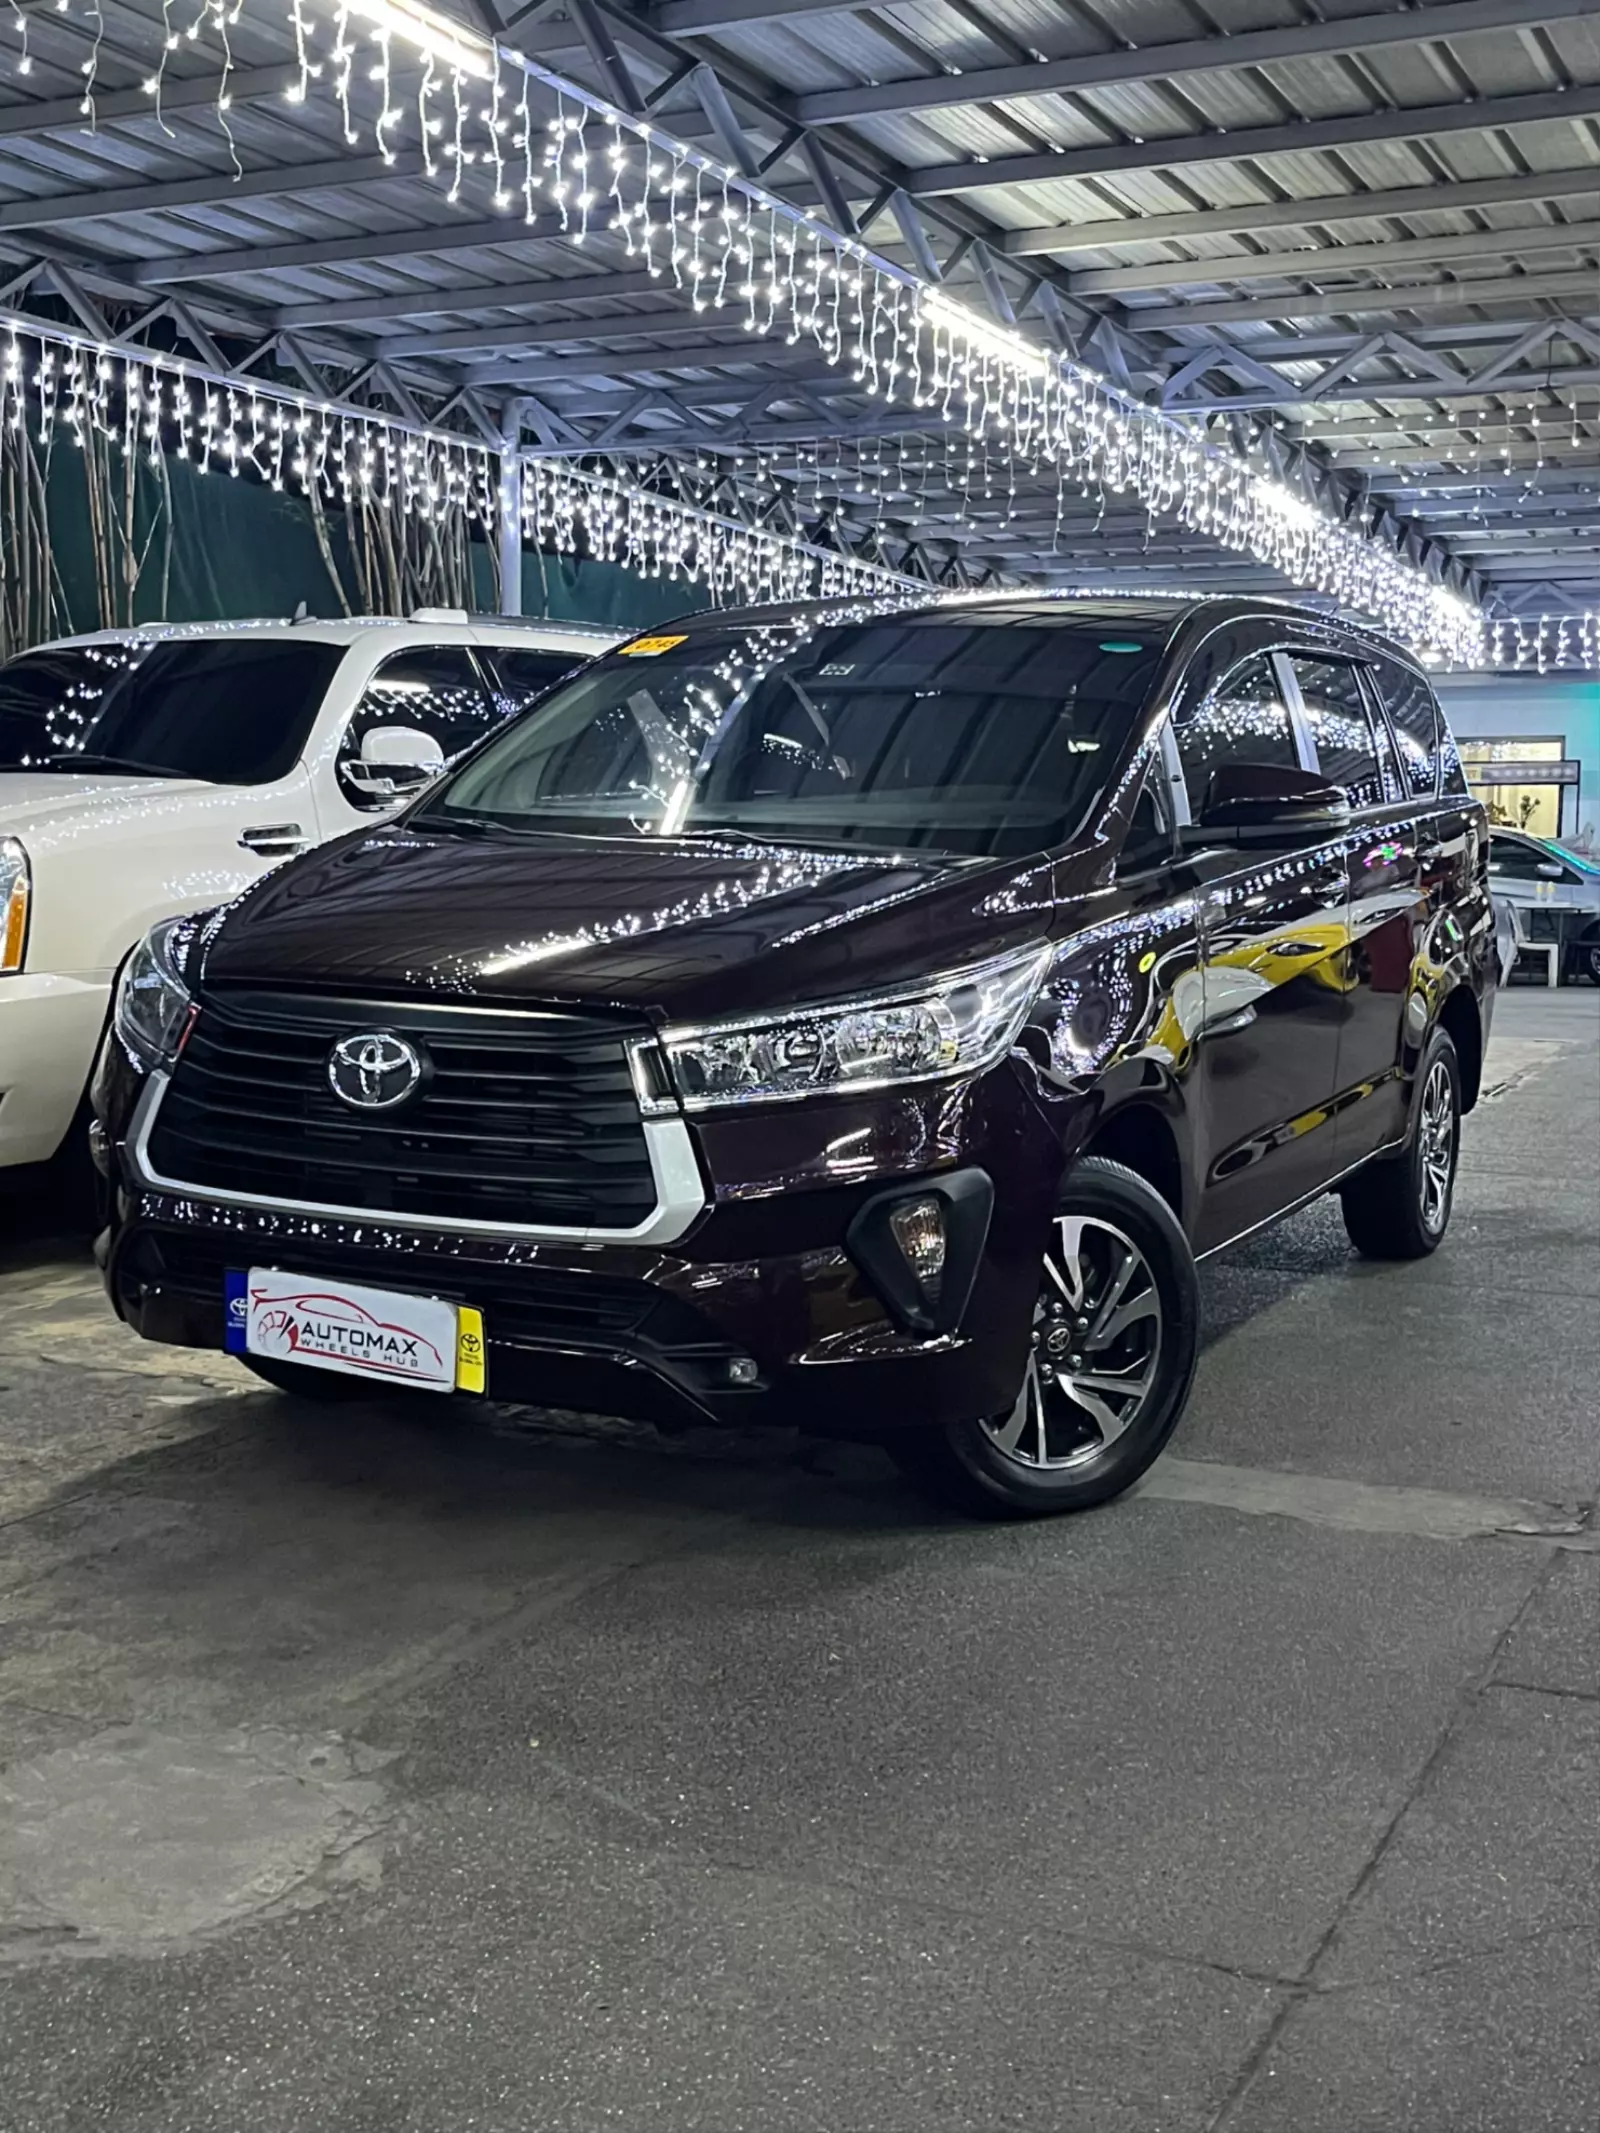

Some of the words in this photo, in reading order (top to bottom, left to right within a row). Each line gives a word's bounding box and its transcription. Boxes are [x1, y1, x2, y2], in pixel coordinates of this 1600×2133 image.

[300, 1338, 371, 1358] WHEELS
[385, 1355, 419, 1368] HUB
[301, 1321, 418, 1356] AUTOMAX
